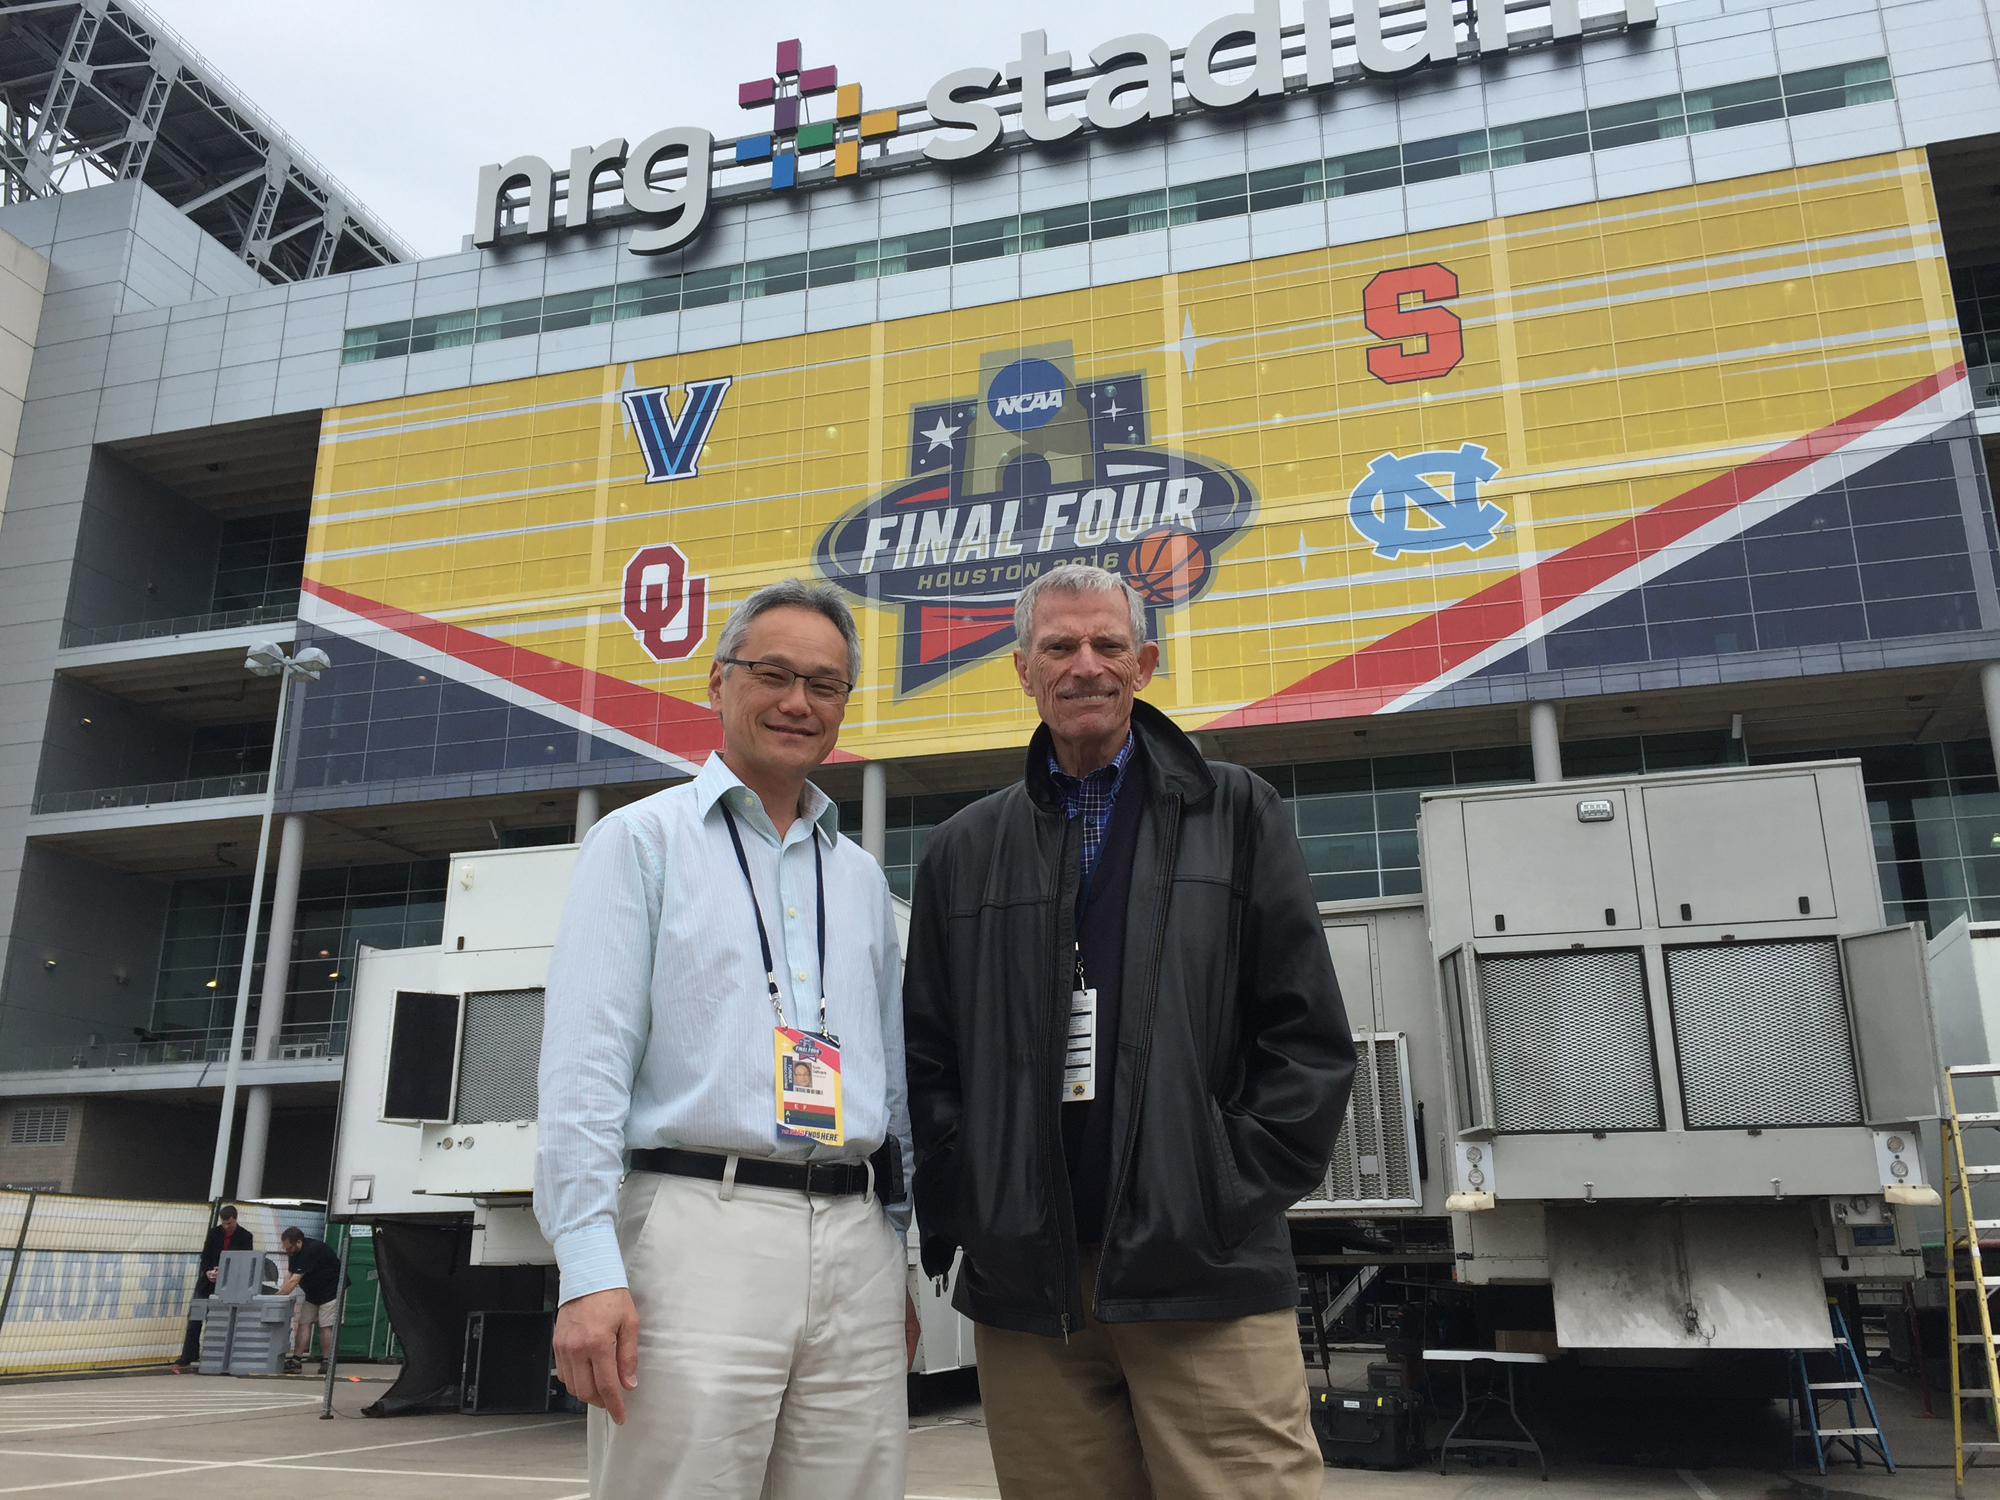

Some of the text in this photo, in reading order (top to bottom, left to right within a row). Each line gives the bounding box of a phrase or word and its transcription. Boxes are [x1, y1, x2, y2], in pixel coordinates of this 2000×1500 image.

[474, 126, 716, 256] nrg
[1363, 262, 1464, 385] S
[622, 375, 733, 485] V
[995, 388, 1063, 417] NCAA
[858, 476, 1204, 575] FINAL FOUR
[917, 561, 1041, 590] HOUSTON
[804, 1130, 821, 1139] ENDS
[820, 1132, 839, 1142] HERE
